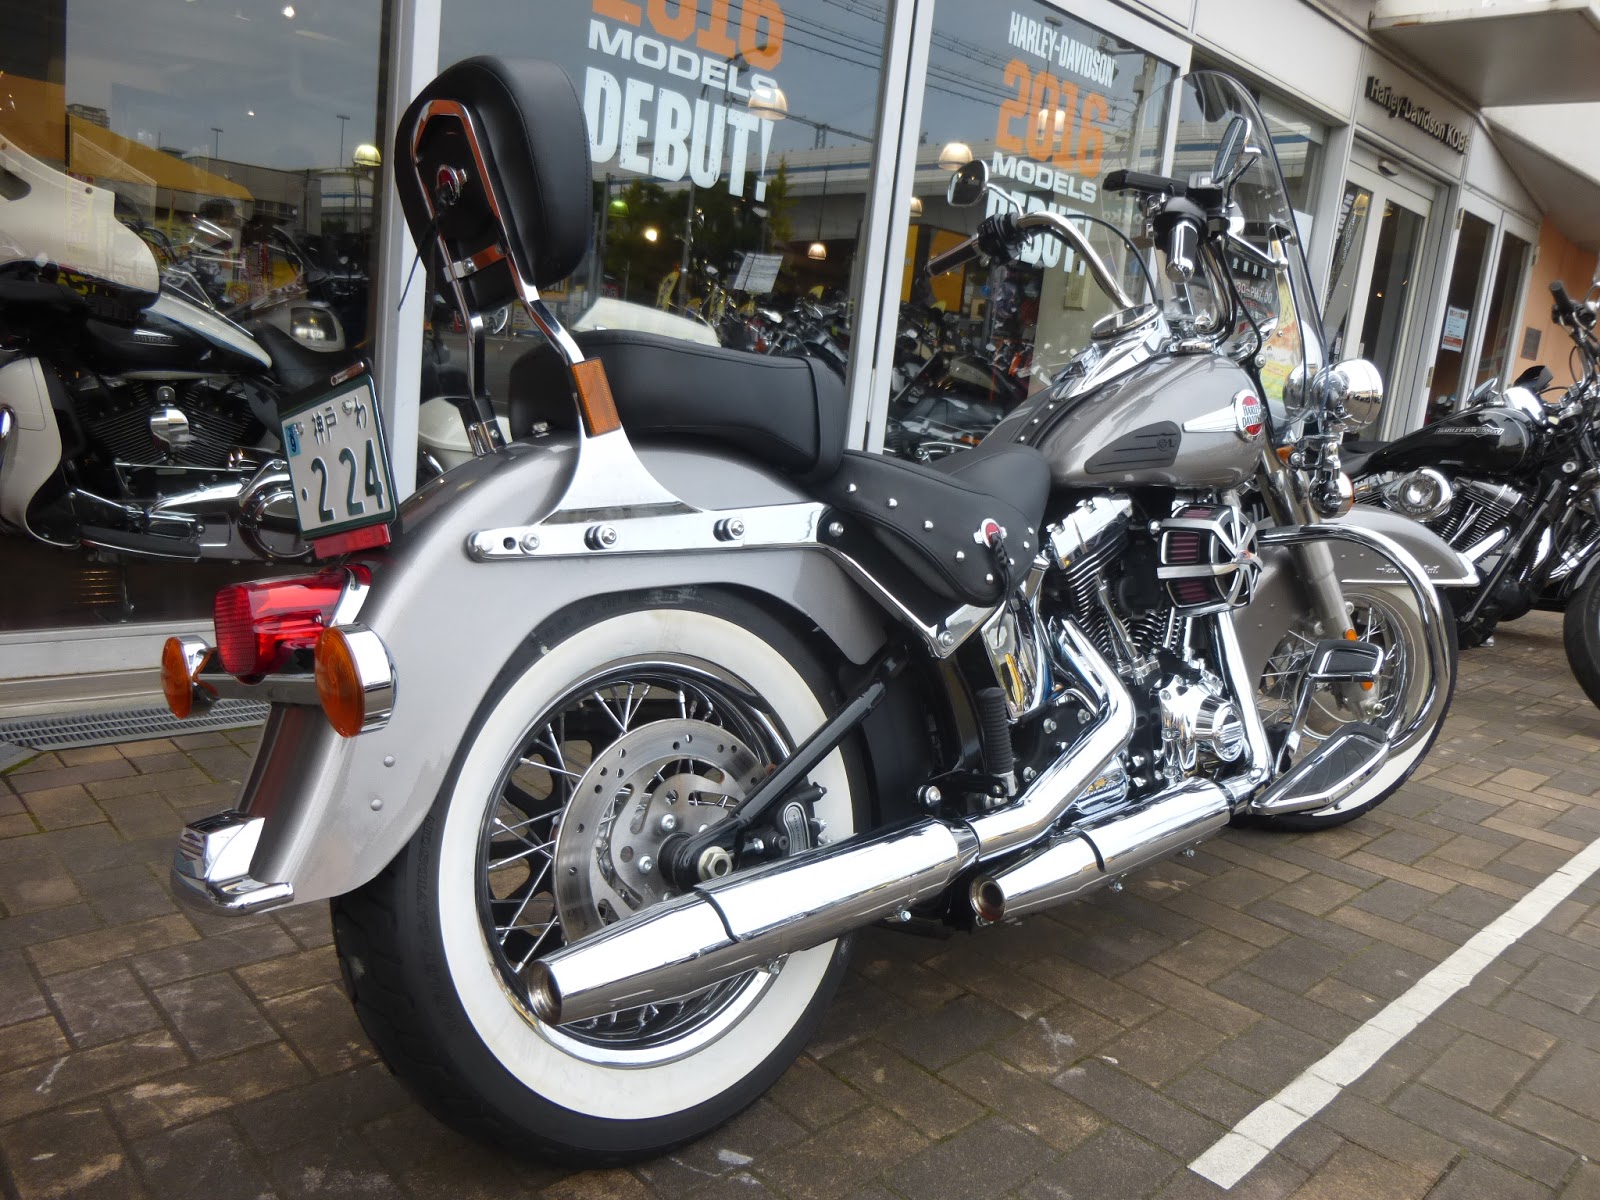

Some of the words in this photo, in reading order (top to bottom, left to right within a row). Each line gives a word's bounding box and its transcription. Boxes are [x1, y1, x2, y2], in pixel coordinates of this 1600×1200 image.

[588, 19, 779, 98] MODELS
[592, 0, 785, 71] 16
[1008, 11, 1116, 88] HARLEY-DAVIDSON
[584, 66, 774, 202] DEBUT!
[996, 59, 1108, 178] 2016
[1365, 76, 1446, 143] Harley-Davidson
[991, 151, 1097, 203] MODELS
[312, 405, 338, 446] 神戸
